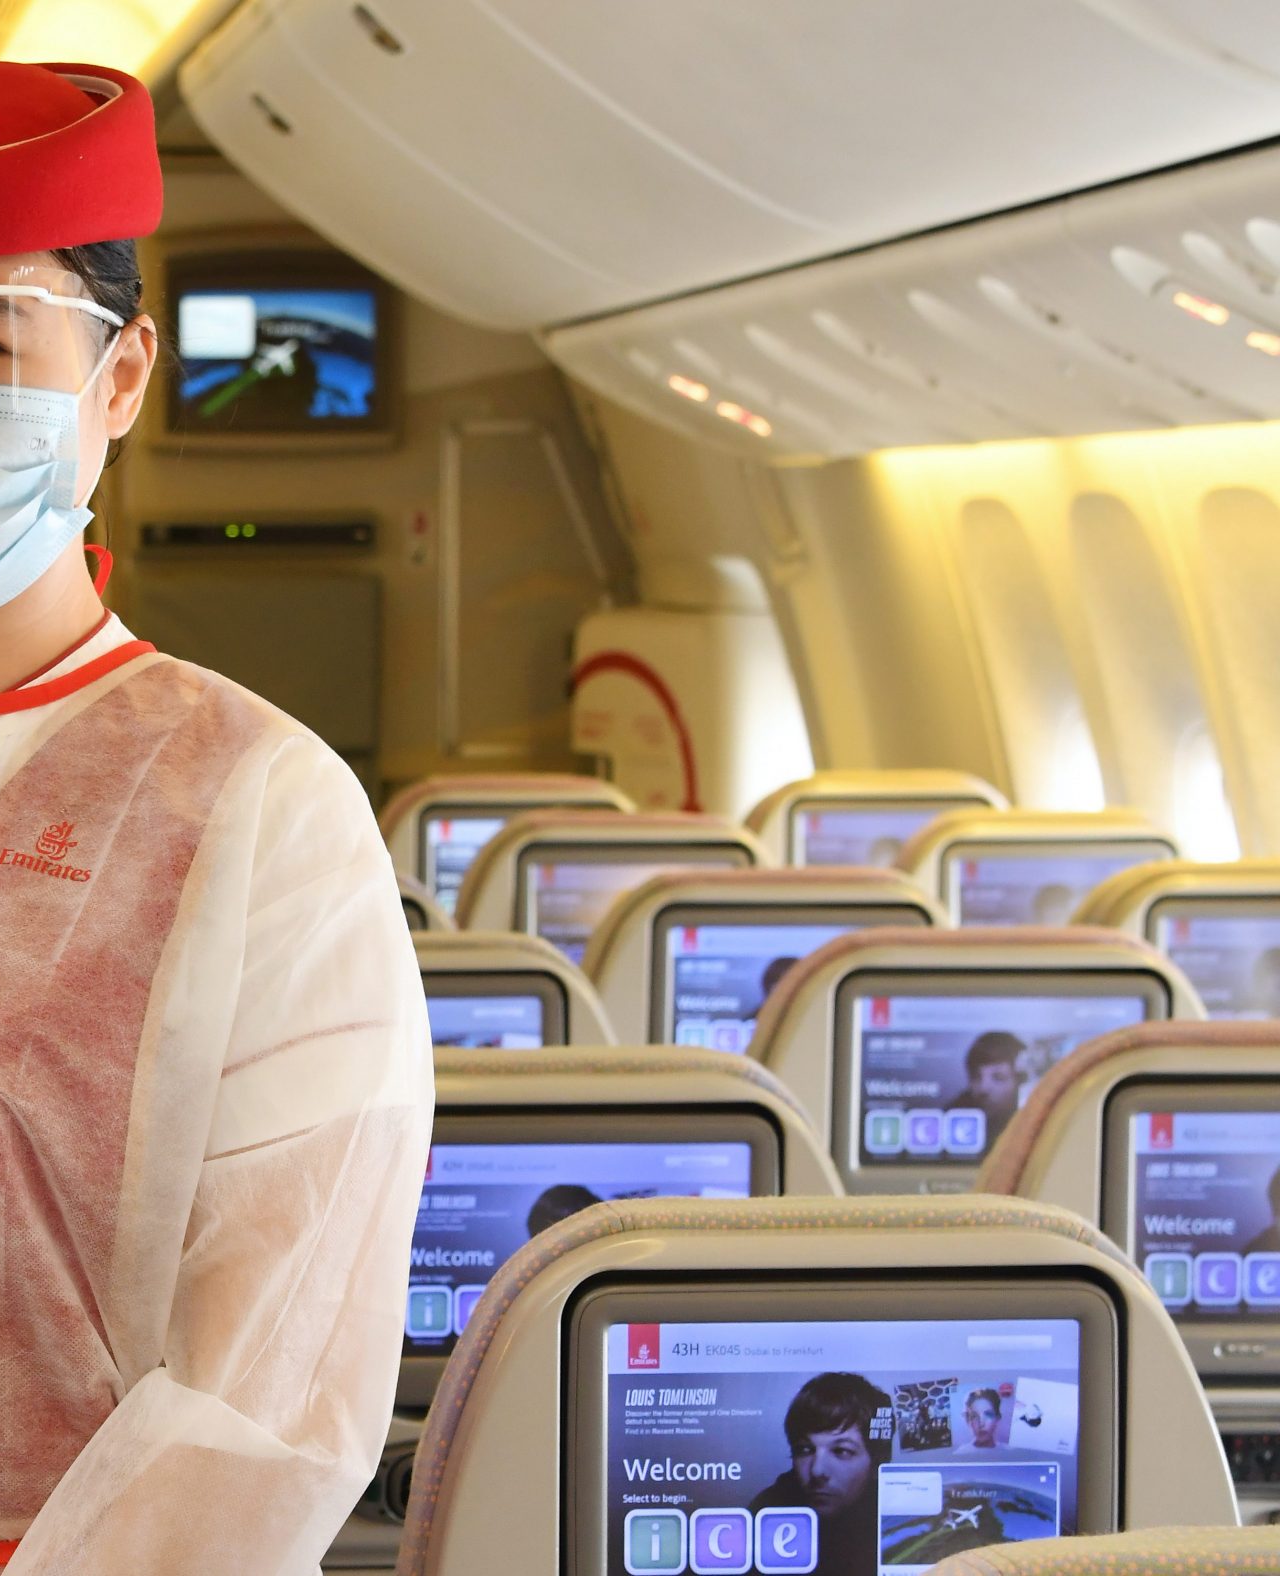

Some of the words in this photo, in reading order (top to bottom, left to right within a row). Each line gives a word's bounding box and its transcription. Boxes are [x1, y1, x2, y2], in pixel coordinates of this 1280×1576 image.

[1144, 1214, 1235, 1235] Welcome
[672, 1343, 699, 1356] 43H
[705, 1345, 740, 1356] EK045
[625, 1389, 655, 1407] LOUIS
[658, 1388, 717, 1406] TOMLINSON
[623, 1457, 742, 1481] Welcome
[623, 1494, 650, 1504] Select
[651, 1495, 660, 1503] to
